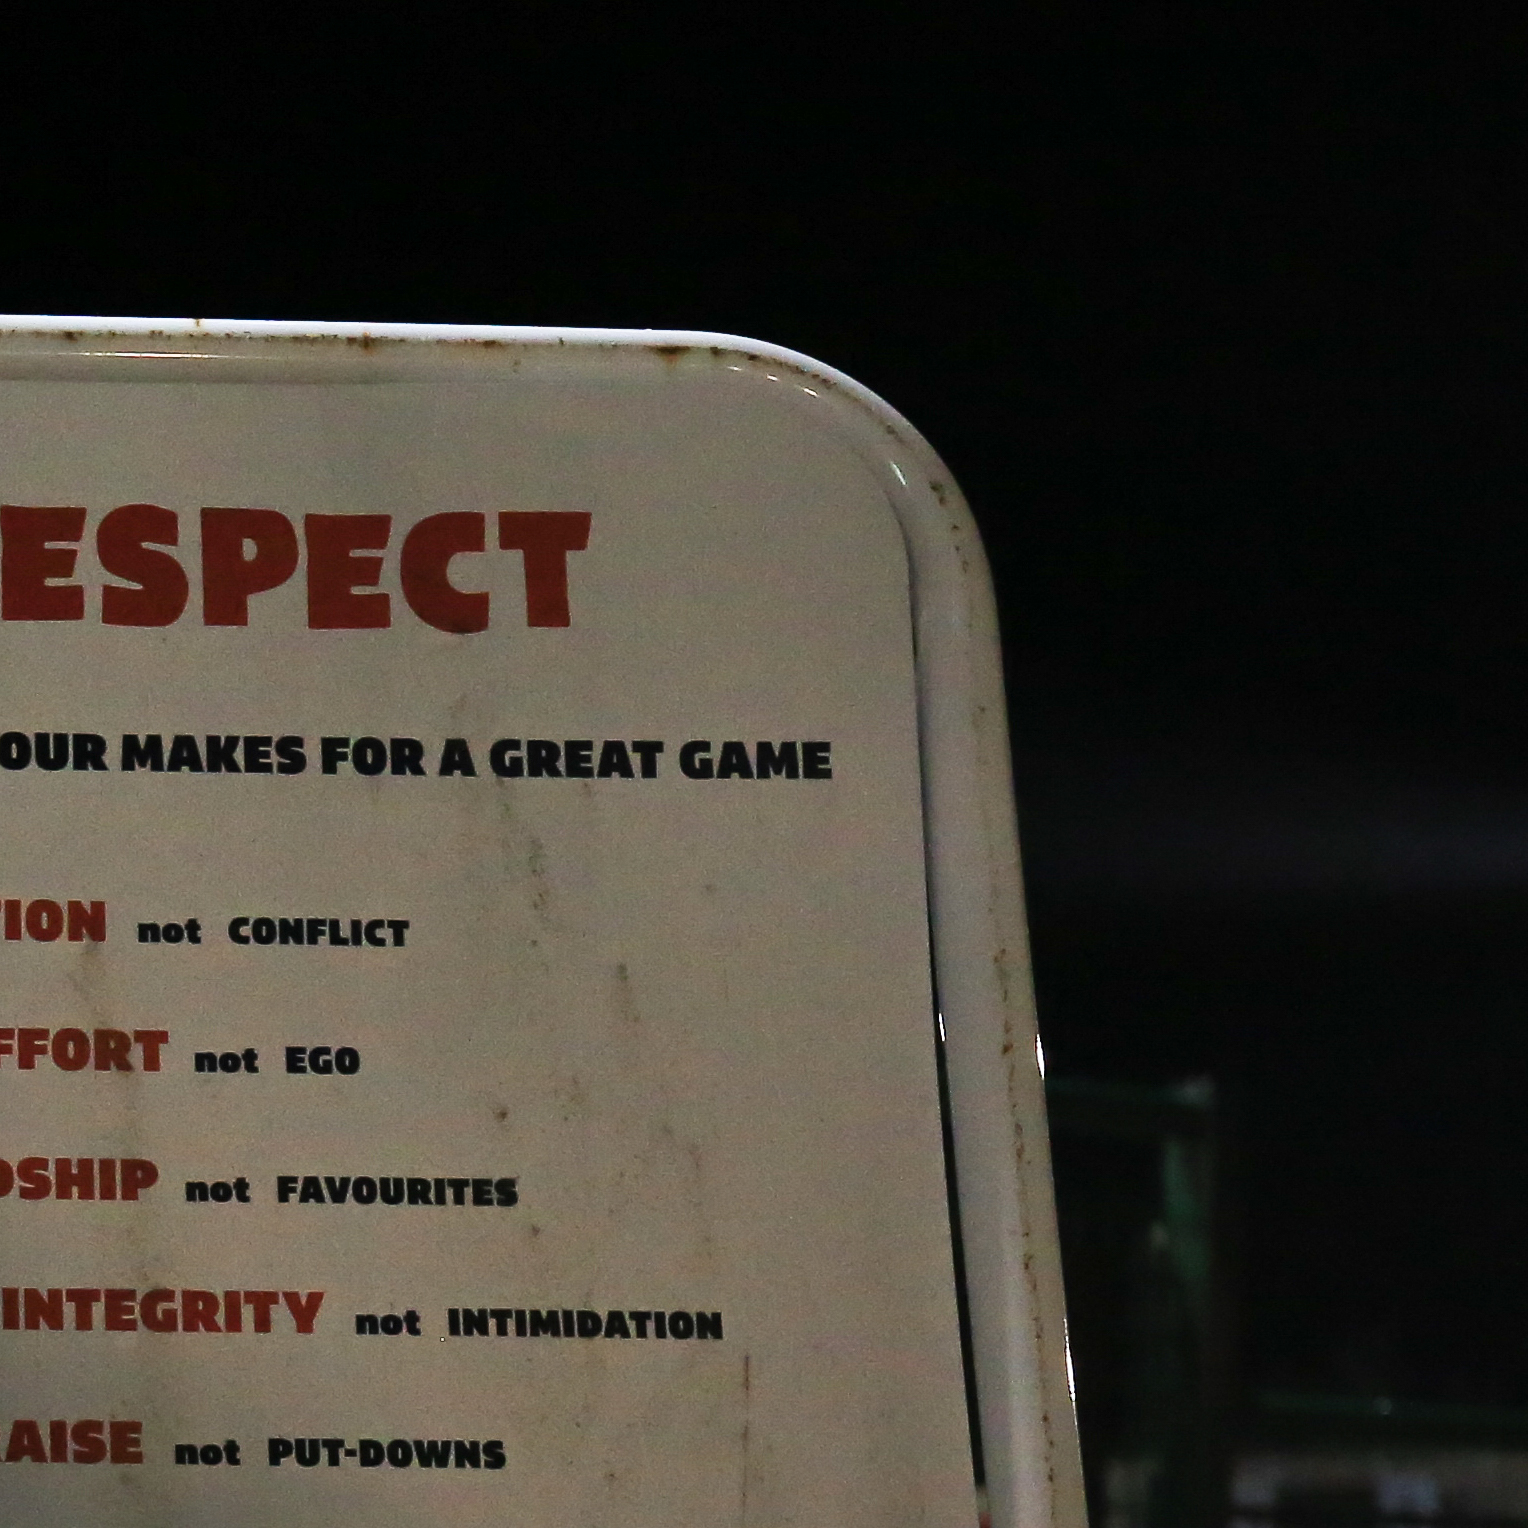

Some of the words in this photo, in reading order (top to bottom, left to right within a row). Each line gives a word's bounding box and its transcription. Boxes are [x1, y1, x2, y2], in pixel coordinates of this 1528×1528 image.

[122, 733, 306, 776] MAKES
[321, 736, 425, 776] FOR
[438, 738, 476, 777] A
[489, 739, 663, 779] GREAT
[678, 741, 832, 780] GAME
[137, 919, 201, 944] not
[228, 916, 409, 947] CONFLICT
[194, 1048, 259, 1073] not
[286, 1046, 360, 1075] EGO
[185, 1177, 250, 1203] not
[277, 1176, 518, 1207] FAVOURITES
[1, 1287, 324, 1333] INTEGRITY
[355, 1310, 420, 1336] not
[447, 1308, 723, 1339] INTIMIDATION
[175, 1439, 240, 1466] not
[267, 1438, 506, 1469] PUT-DOWNS
